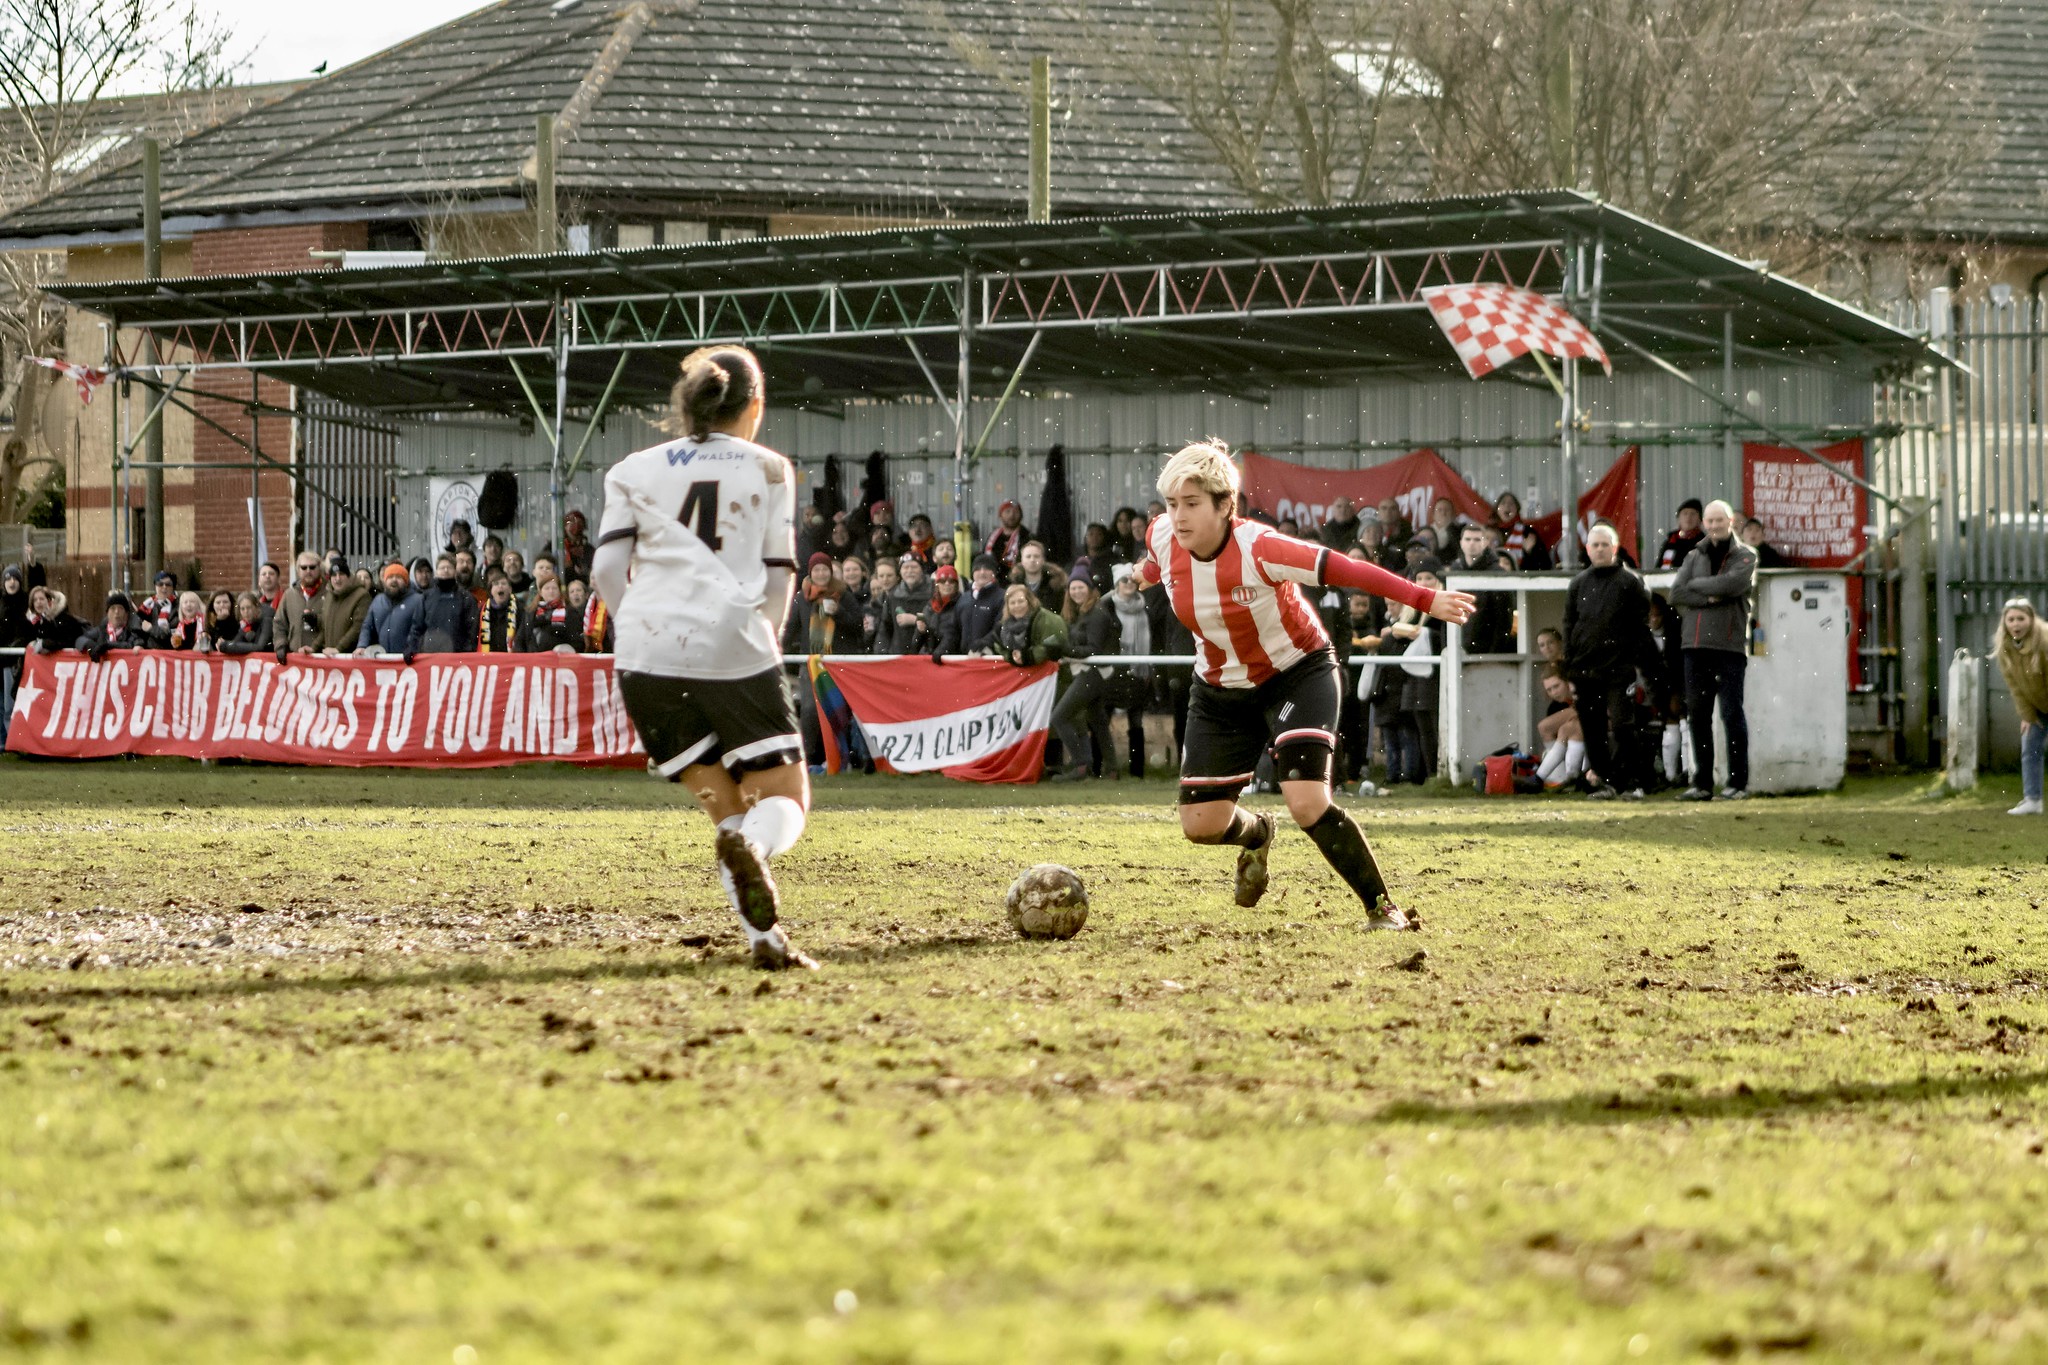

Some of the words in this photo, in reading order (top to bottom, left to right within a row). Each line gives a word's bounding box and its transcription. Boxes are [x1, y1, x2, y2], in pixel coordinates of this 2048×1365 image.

[697, 451, 744, 461] WALSH
[677, 480, 723, 552] 4
[42, 658, 129, 741] THIS
[130, 655, 212, 741] CLUB
[212, 658, 365, 751] BELONGS
[367, 667, 418, 752] TO
[424, 664, 498, 754] YOU
[500, 666, 579, 755] AND
[592, 668, 647, 755] M
[934, 700, 1024, 760] CLAPTON
